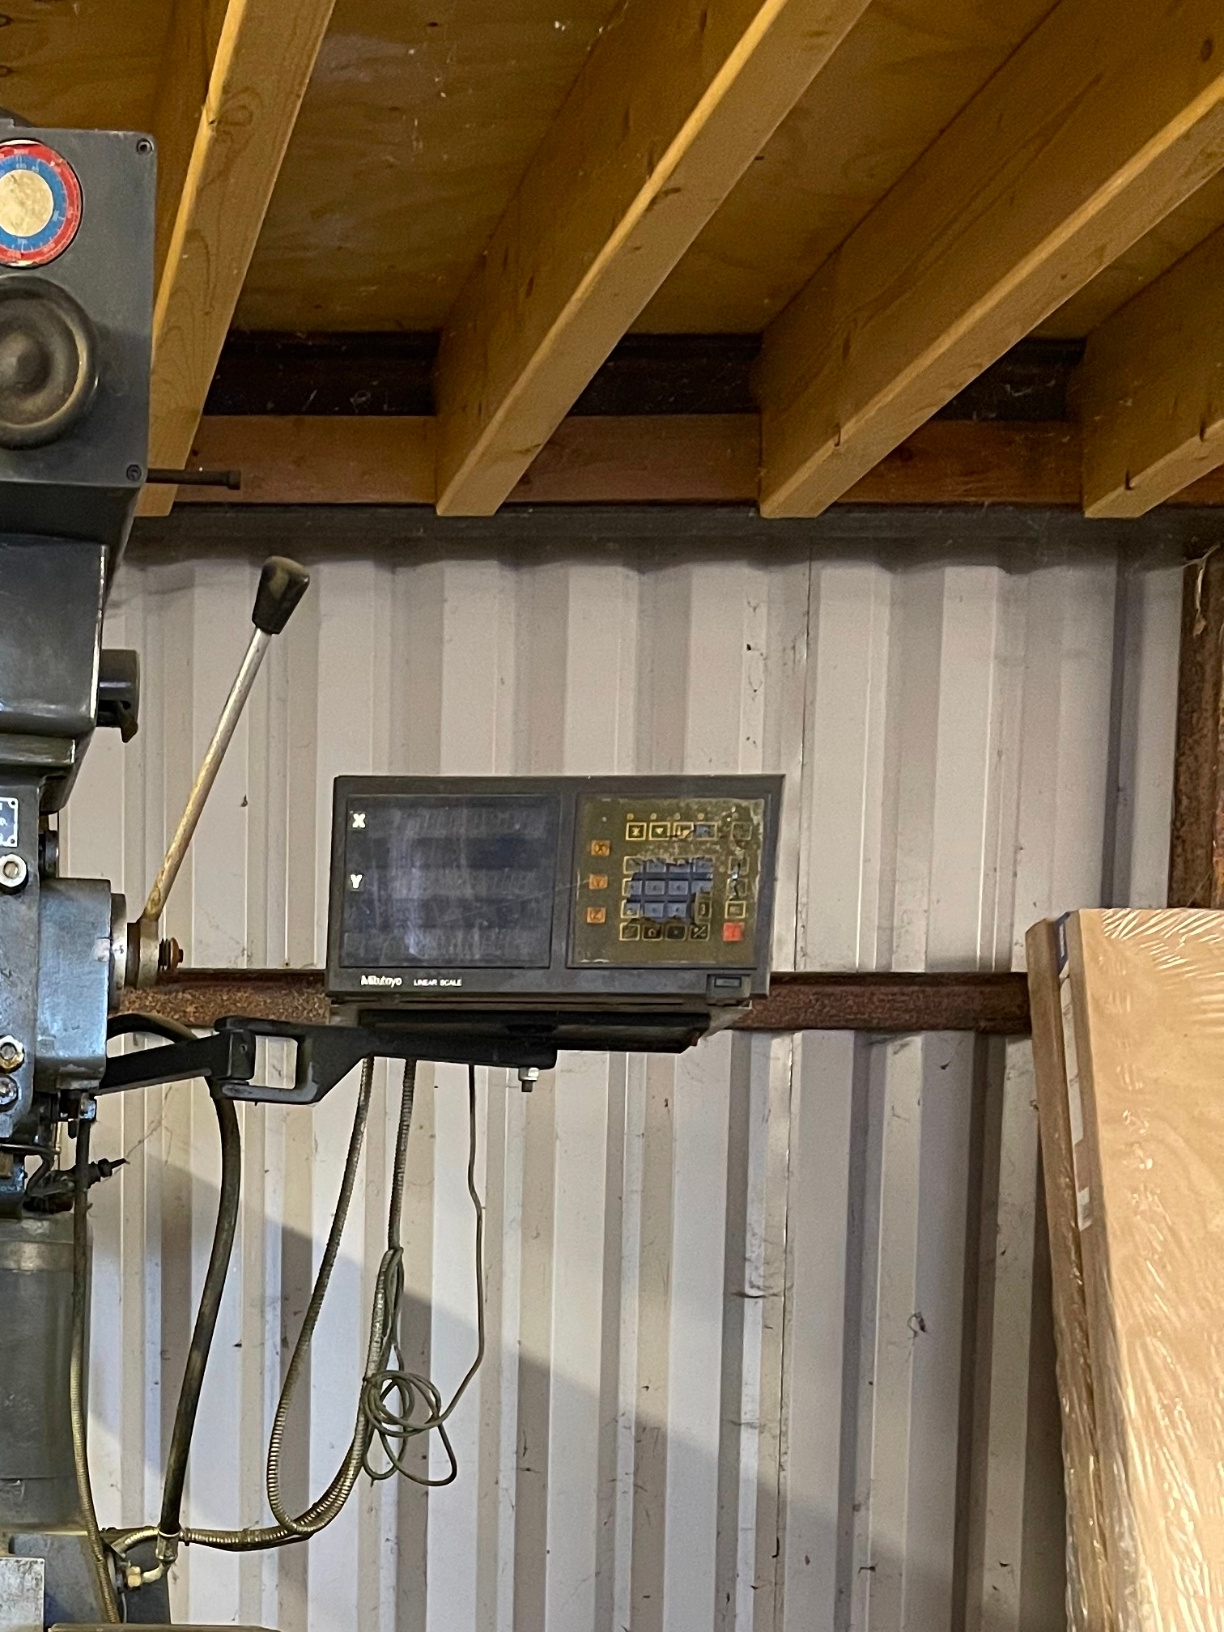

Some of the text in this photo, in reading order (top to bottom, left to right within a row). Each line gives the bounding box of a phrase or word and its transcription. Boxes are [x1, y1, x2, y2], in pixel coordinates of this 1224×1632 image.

[352, 813, 366, 828] X
[350, 874, 363, 889] Y
[360, 975, 402, 987] Mitutoyo
